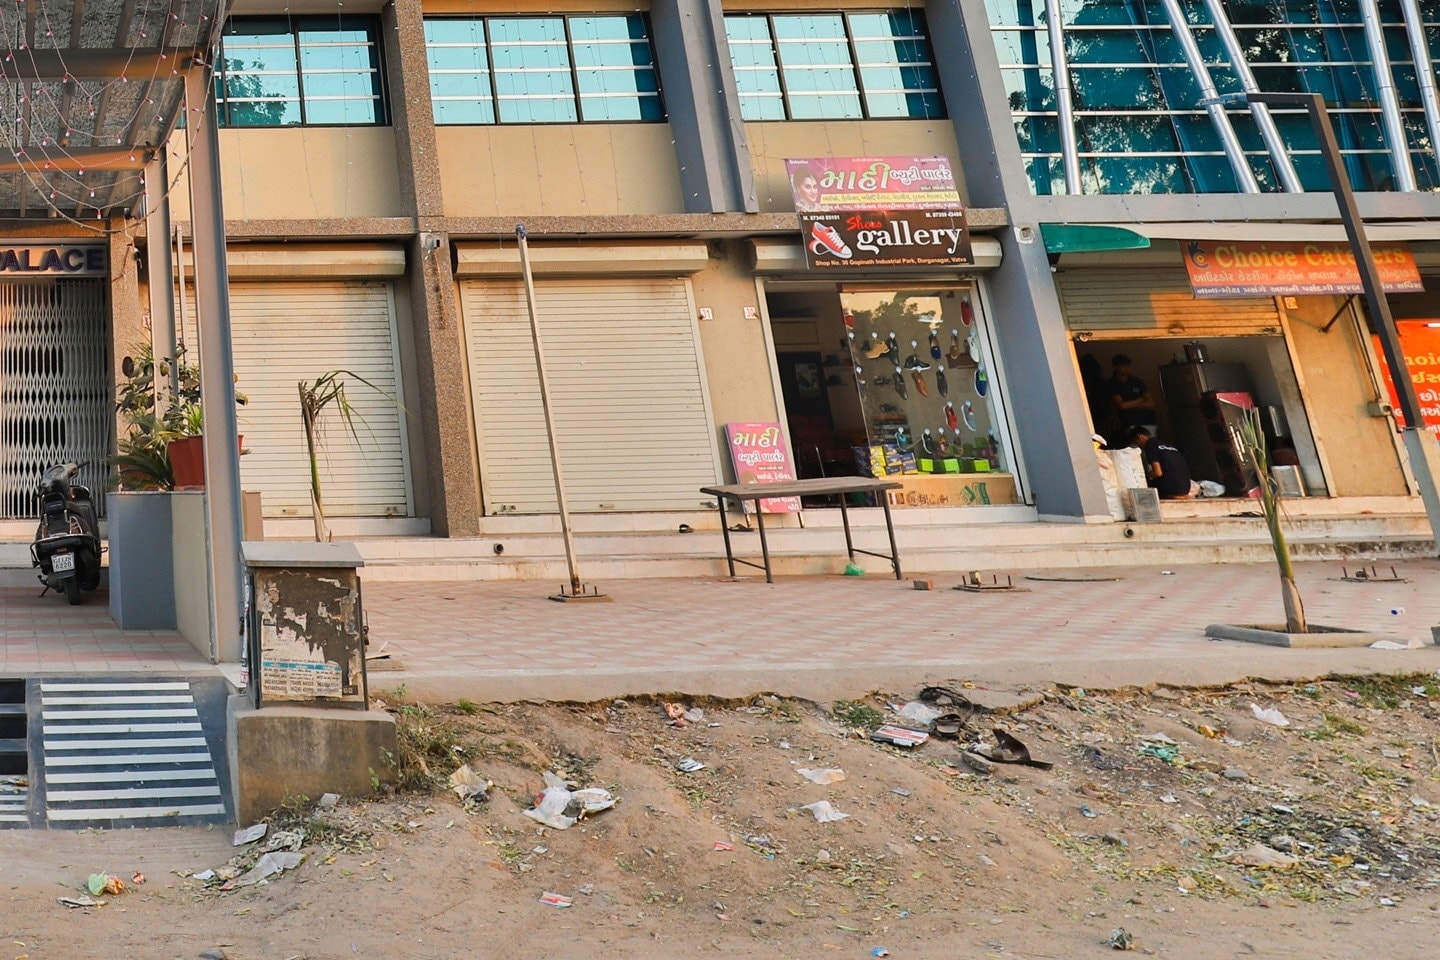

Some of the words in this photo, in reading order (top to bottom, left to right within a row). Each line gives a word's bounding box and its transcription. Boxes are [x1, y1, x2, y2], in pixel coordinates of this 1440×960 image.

[820, 162, 891, 191] માહી
[890, 166, 920, 185] બ્યુટી
[923, 164, 953, 181] પાર્લર
[857, 220, 962, 255] gallery
[849, 258, 875, 267] Gopinath
[875, 257, 902, 265] Industrial
[1215, 245, 1299, 269] Choice
[1304, 244, 1407, 267] Cateers
[733, 427, 779, 448] માહી
